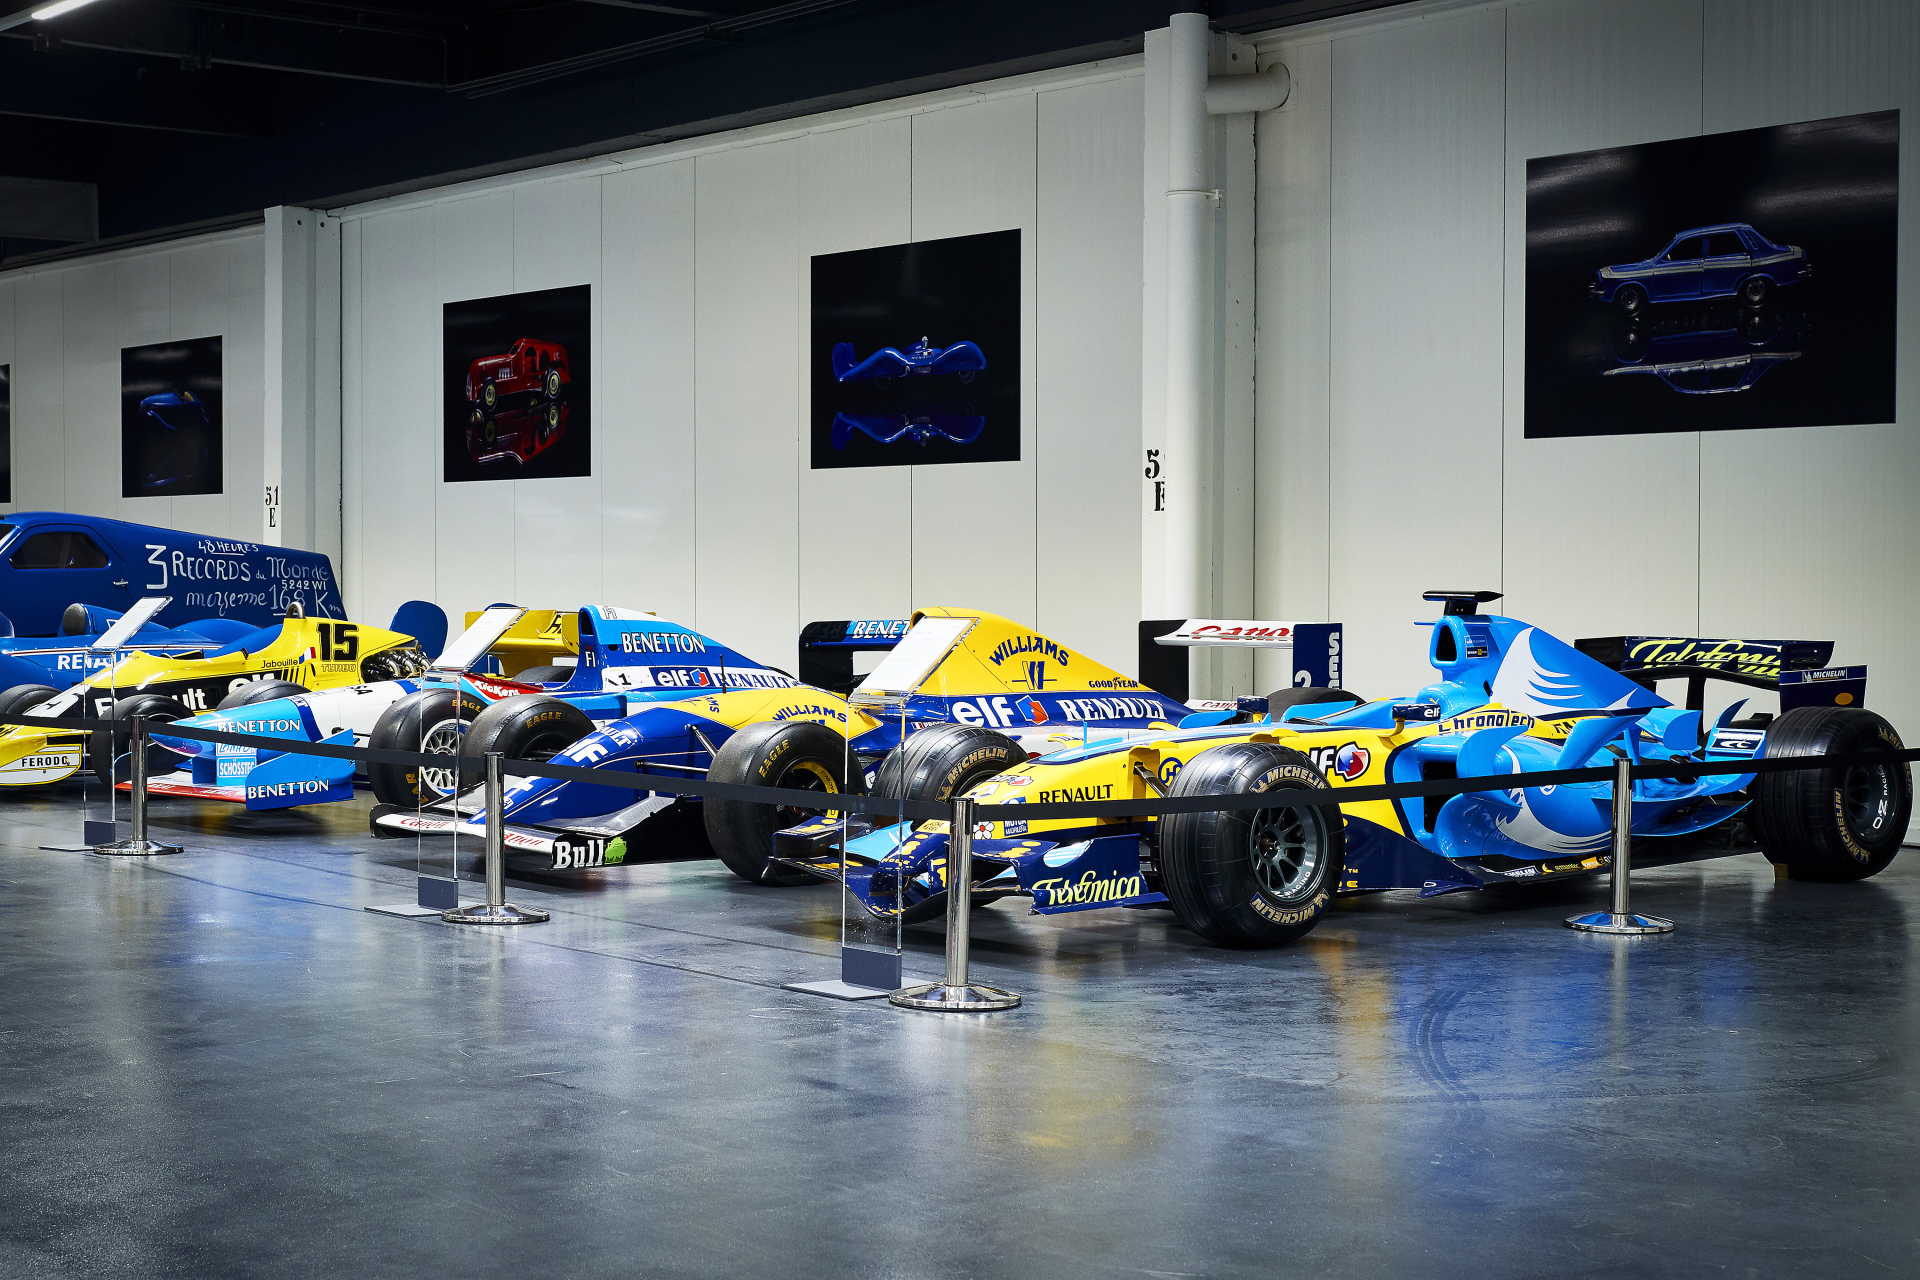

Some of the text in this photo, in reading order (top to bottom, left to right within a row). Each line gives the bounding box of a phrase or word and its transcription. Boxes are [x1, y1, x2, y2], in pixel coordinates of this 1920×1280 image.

[265, 486, 279, 505] 51
[269, 508, 277, 527] E
[198, 539, 259, 554] 48 HEURES
[145, 544, 330, 590] 3 RECORDS du Monde
[281, 580, 310, 590] 5242
[316, 622, 360, 662] 15
[620, 631, 707, 655] BENETTON
[988, 635, 1070, 668] WILLIAMS
[260, 658, 299, 669] Jabouille
[321, 664, 357, 673] TURBO
[656, 668, 691, 686] elf
[712, 671, 792, 689] RENAULT
[1812, 669, 1846, 679] MICHELIN
[452, 699, 484, 713] EAGL
[772, 704, 848, 723] WILLIAMS
[951, 696, 1016, 728] elf
[1055, 697, 1168, 722] RENAULT
[1424, 707, 1441, 718] elf
[217, 719, 301, 734] BENETTON
[526, 710, 563, 729] EAGLE
[21, 754, 70, 768] FERODO
[758, 738, 790, 778] EAGLE
[947, 748, 1008, 784] MICHELIN
[247, 779, 330, 800] BENETTON
[1039, 784, 1114, 804] RENAULT
[1835, 791, 1860, 858] MICHELIN
[552, 839, 604, 869] Bull
[1251, 897, 1315, 924] MICHELIN
